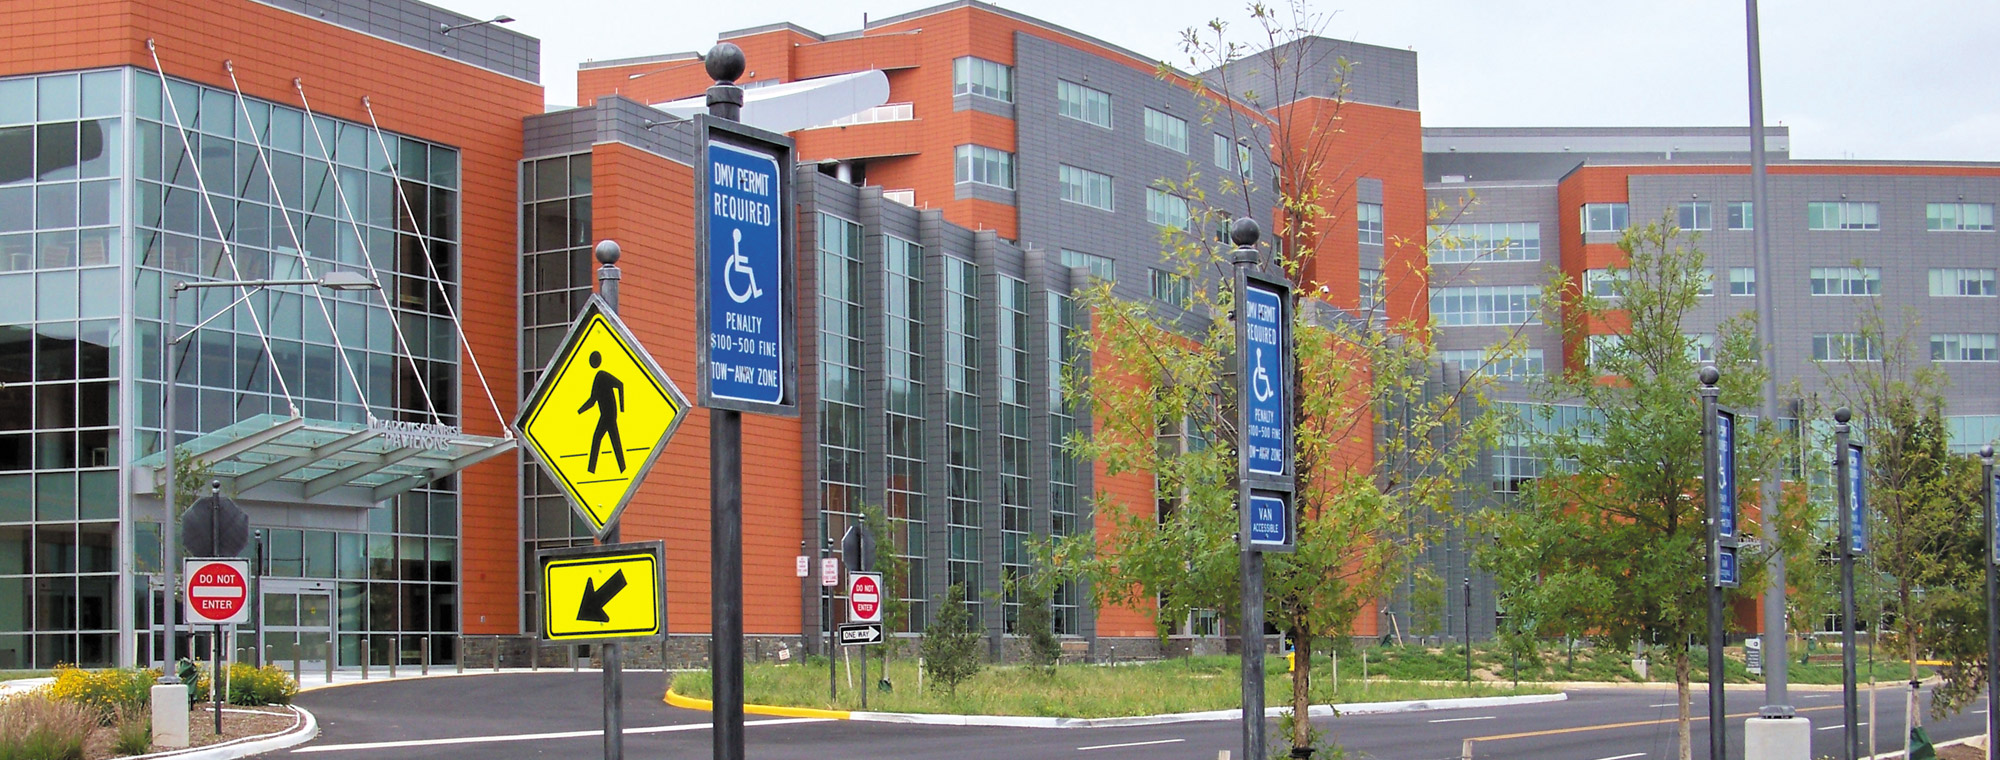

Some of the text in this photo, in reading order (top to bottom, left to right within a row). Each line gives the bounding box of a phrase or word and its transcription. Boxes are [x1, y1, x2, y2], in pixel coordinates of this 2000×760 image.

[714, 162, 769, 197] DMV PERMIT
[714, 192, 771, 227] REQUIRED
[1258, 303, 1276, 324] PERMIT
[726, 311, 763, 334] PENALTY
[1247, 322, 1277, 346] REQUIRED
[710, 333, 777, 358] $100-500 FINE
[757, 367, 778, 388] ZONE
[1255, 408, 1274, 424] PENALTY
[1271, 427, 1282, 440] FINE
[1248, 444, 1282, 462] OW-AWAY ZONE
[1258, 508, 1273, 521] VAN
[1252, 523, 1279, 533] ACCESSIBLE
[199, 574, 236, 584] DO NOT
[202, 600, 232, 609] ENTER
[857, 604, 874, 612] ENTER
[844, 630, 870, 639] ONE WAY
